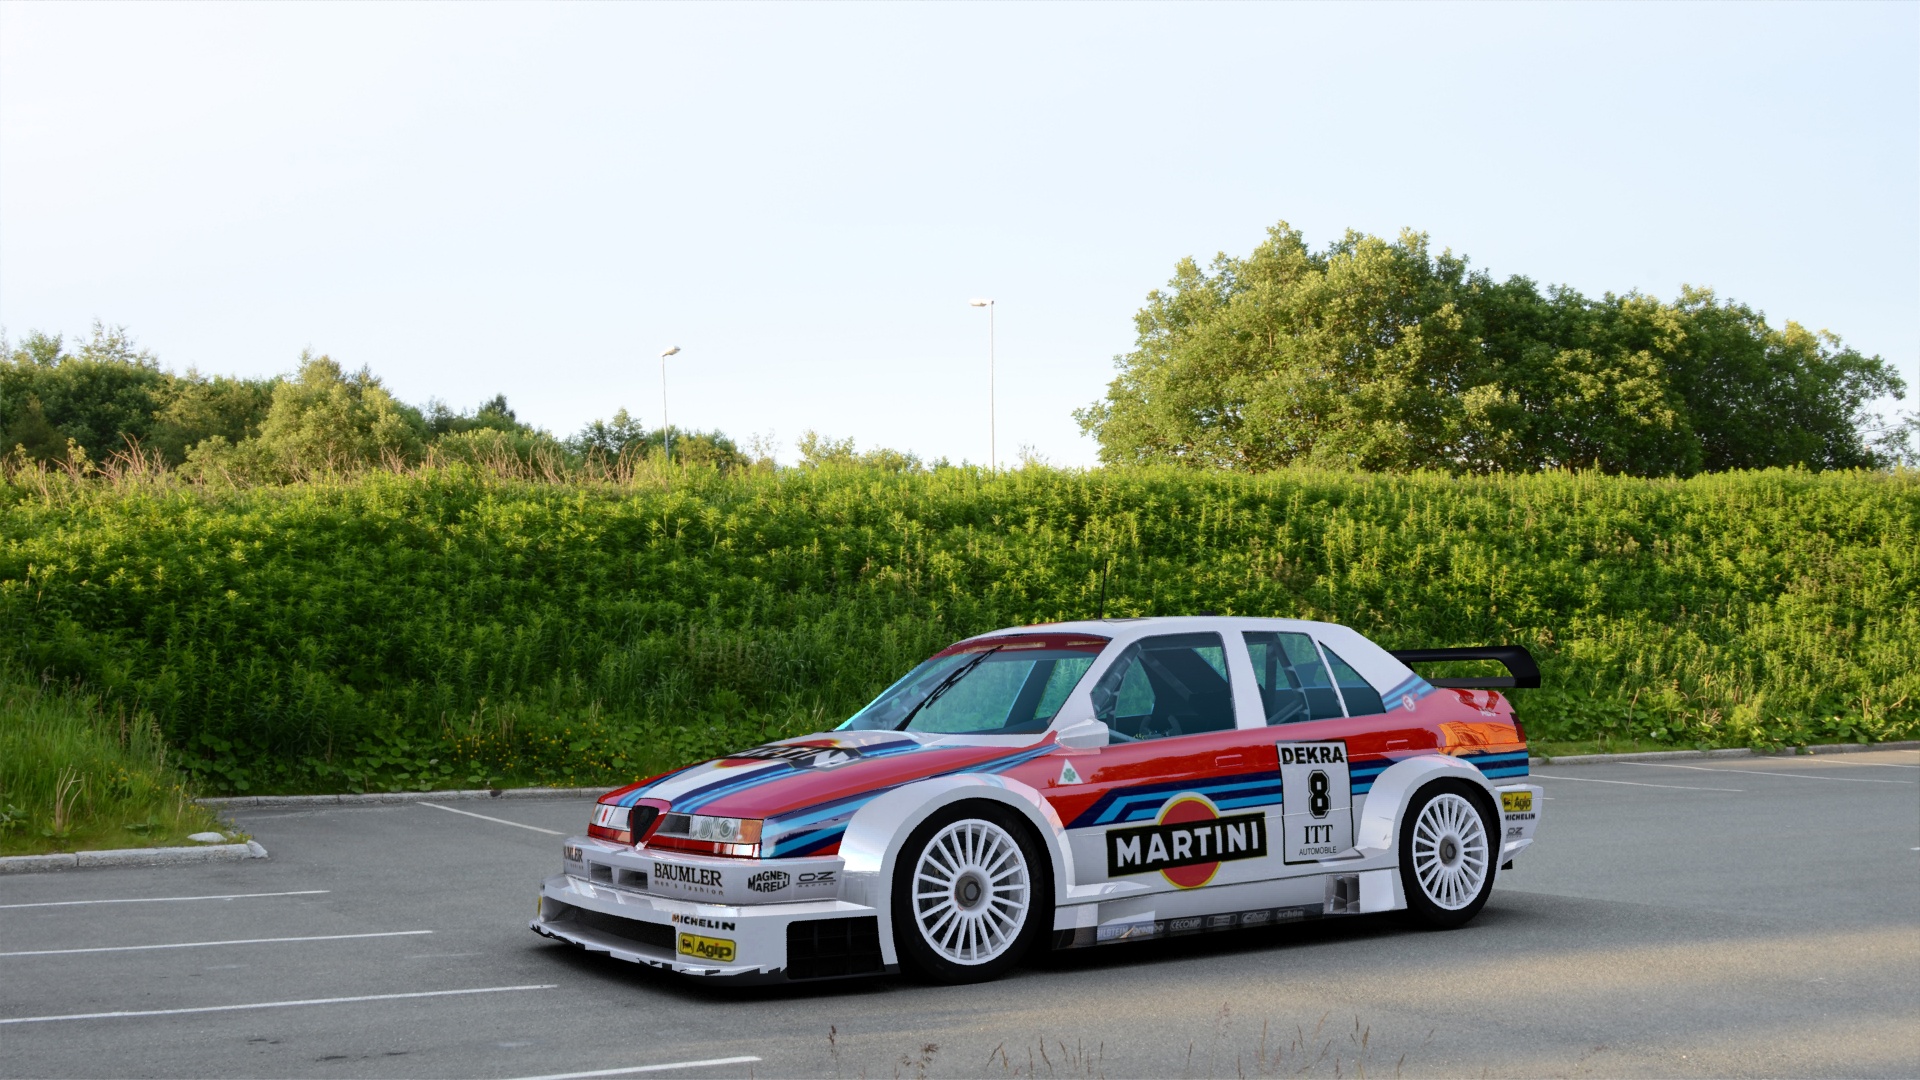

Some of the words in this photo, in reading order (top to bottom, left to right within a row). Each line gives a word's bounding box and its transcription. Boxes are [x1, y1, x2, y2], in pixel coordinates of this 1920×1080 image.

[1281, 746, 1345, 765] DEKRA
[1308, 769, 1331, 819] 8
[1303, 824, 1334, 844] ITT
[1115, 821, 1260, 868] MARTINI
[1299, 846, 1337, 856] AUTOMOBILE
[653, 862, 723, 888] BÄUMLER
[748, 870, 790, 885] MAGNETI
[654, 879, 678, 889] men's
[683, 884, 724, 896] fashion
[748, 877, 790, 893] MARELLI
[672, 913, 736, 931] MICHELIN
[1171, 919, 1200, 929] CECOMP
[696, 940, 732, 958] Agip
